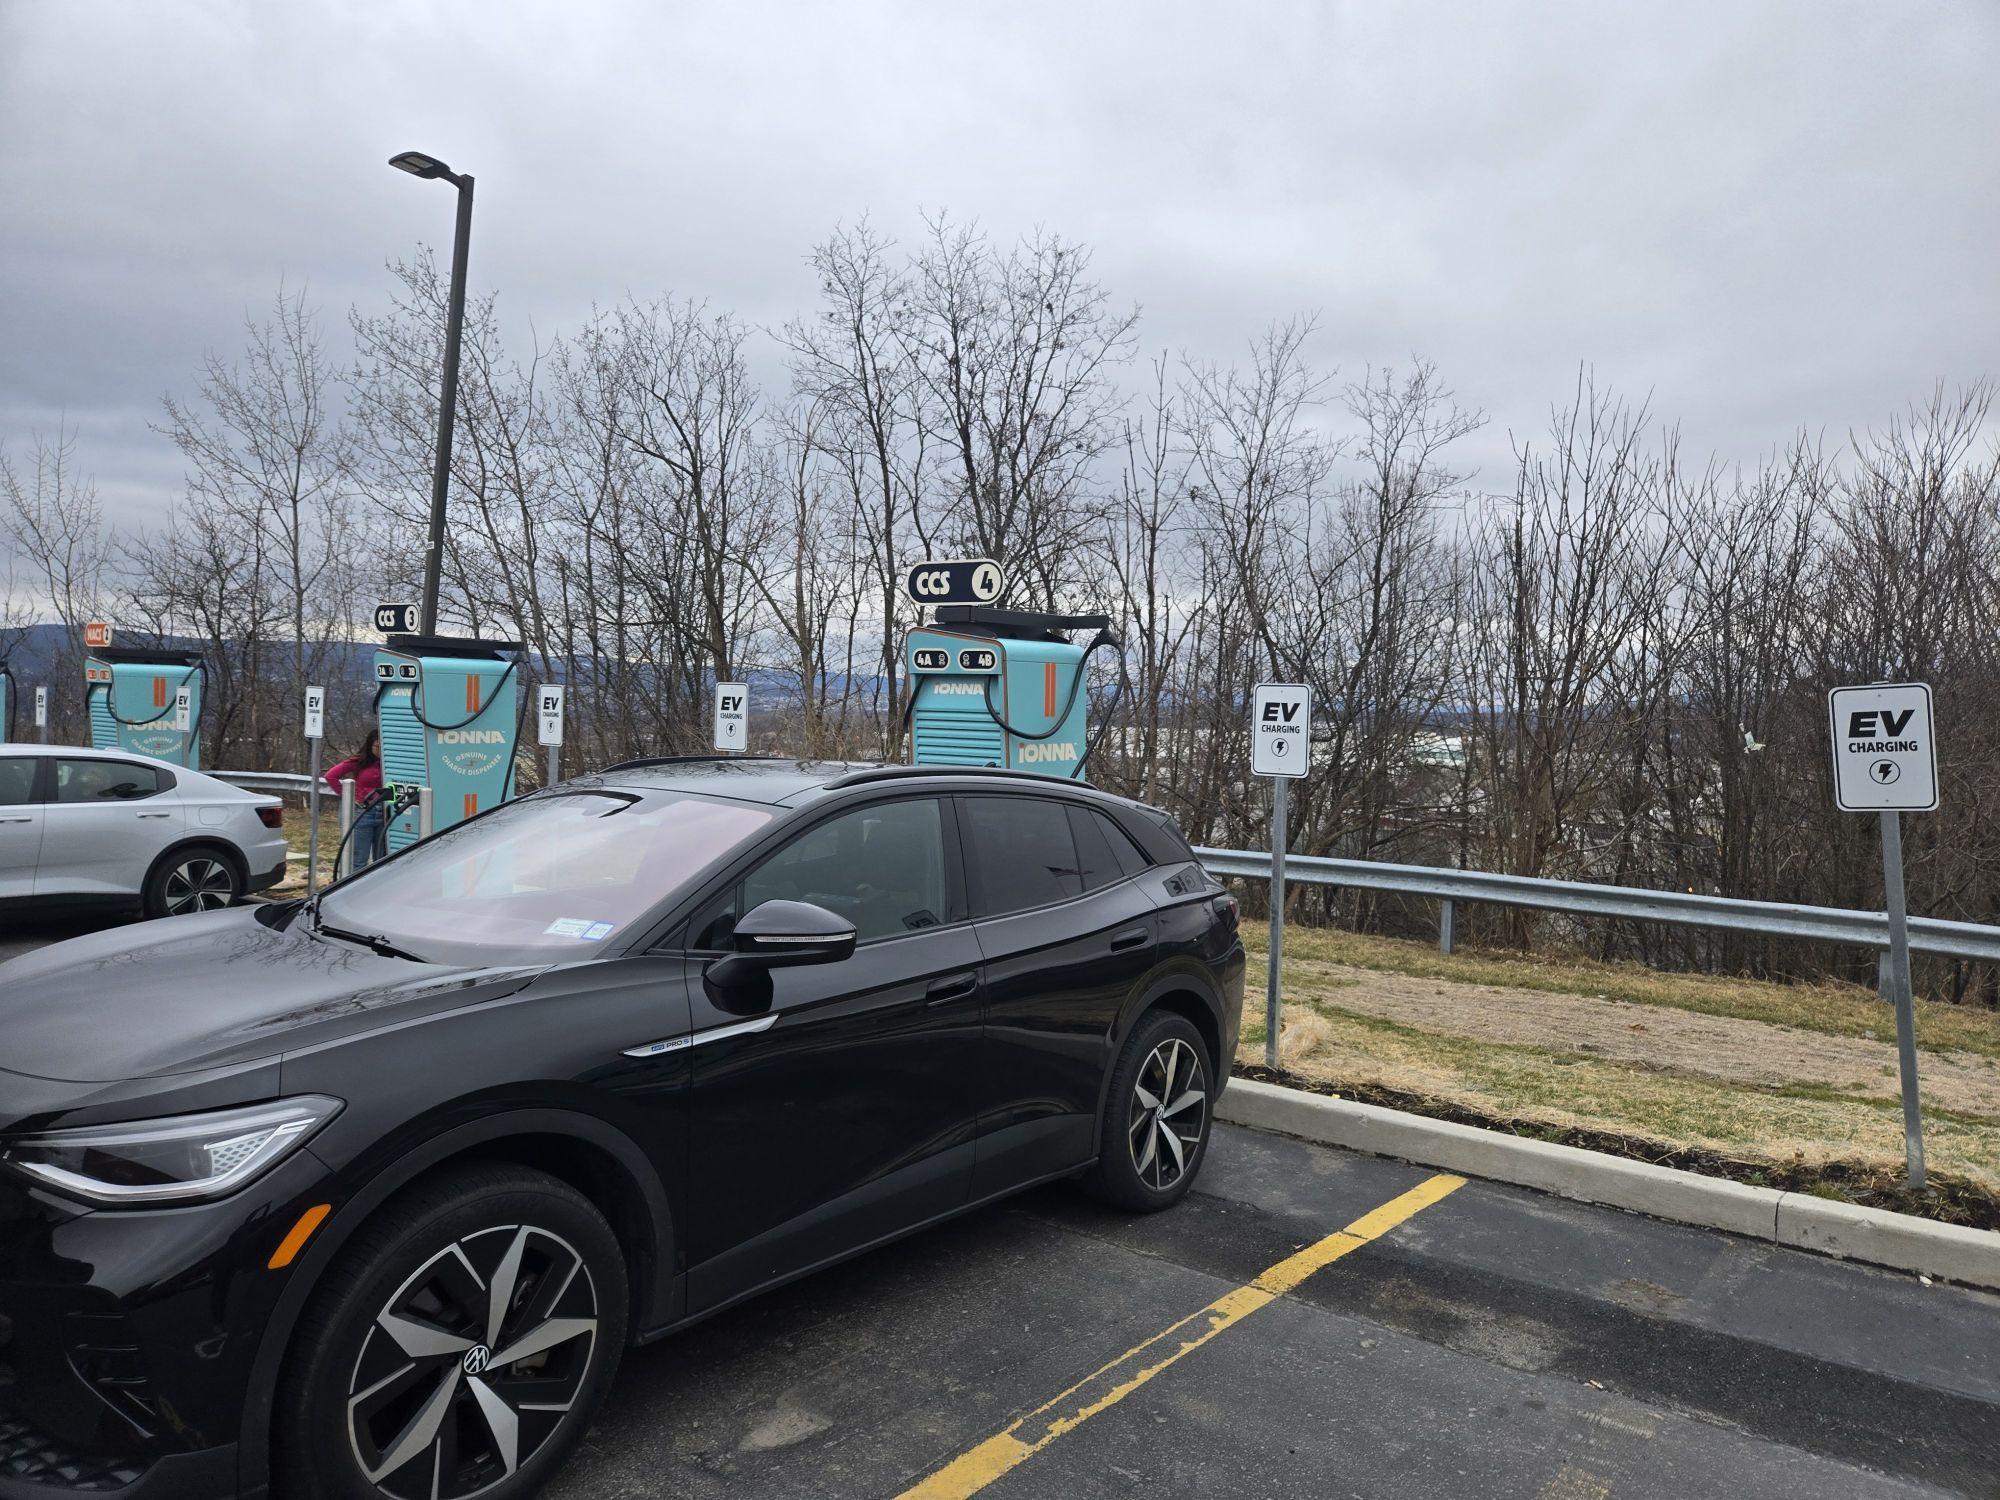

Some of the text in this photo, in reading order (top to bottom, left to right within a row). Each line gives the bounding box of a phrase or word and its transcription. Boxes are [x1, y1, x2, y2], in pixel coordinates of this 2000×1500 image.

[916, 571, 994, 595] CCS 4
[377, 610, 415, 627] CCS 3
[917, 653, 933, 666] 4A
[978, 654, 993, 667] 4B
[178, 695, 189, 705] EV
[309, 696, 321, 708] EV
[543, 696, 560, 710] EV
[720, 696, 743, 711] EV
[720, 712, 743, 720] CHARGING
[1262, 702, 1301, 722] EV
[1261, 724, 1300, 734] CHARGING
[1848, 709, 1916, 738] EV
[1848, 740, 1918, 753] CHARGING
[455, 751, 488, 762] GENUINE
[441, 754, 502, 775] CHARGE DISPENSER
[666, 1040, 683, 1048] PRO
